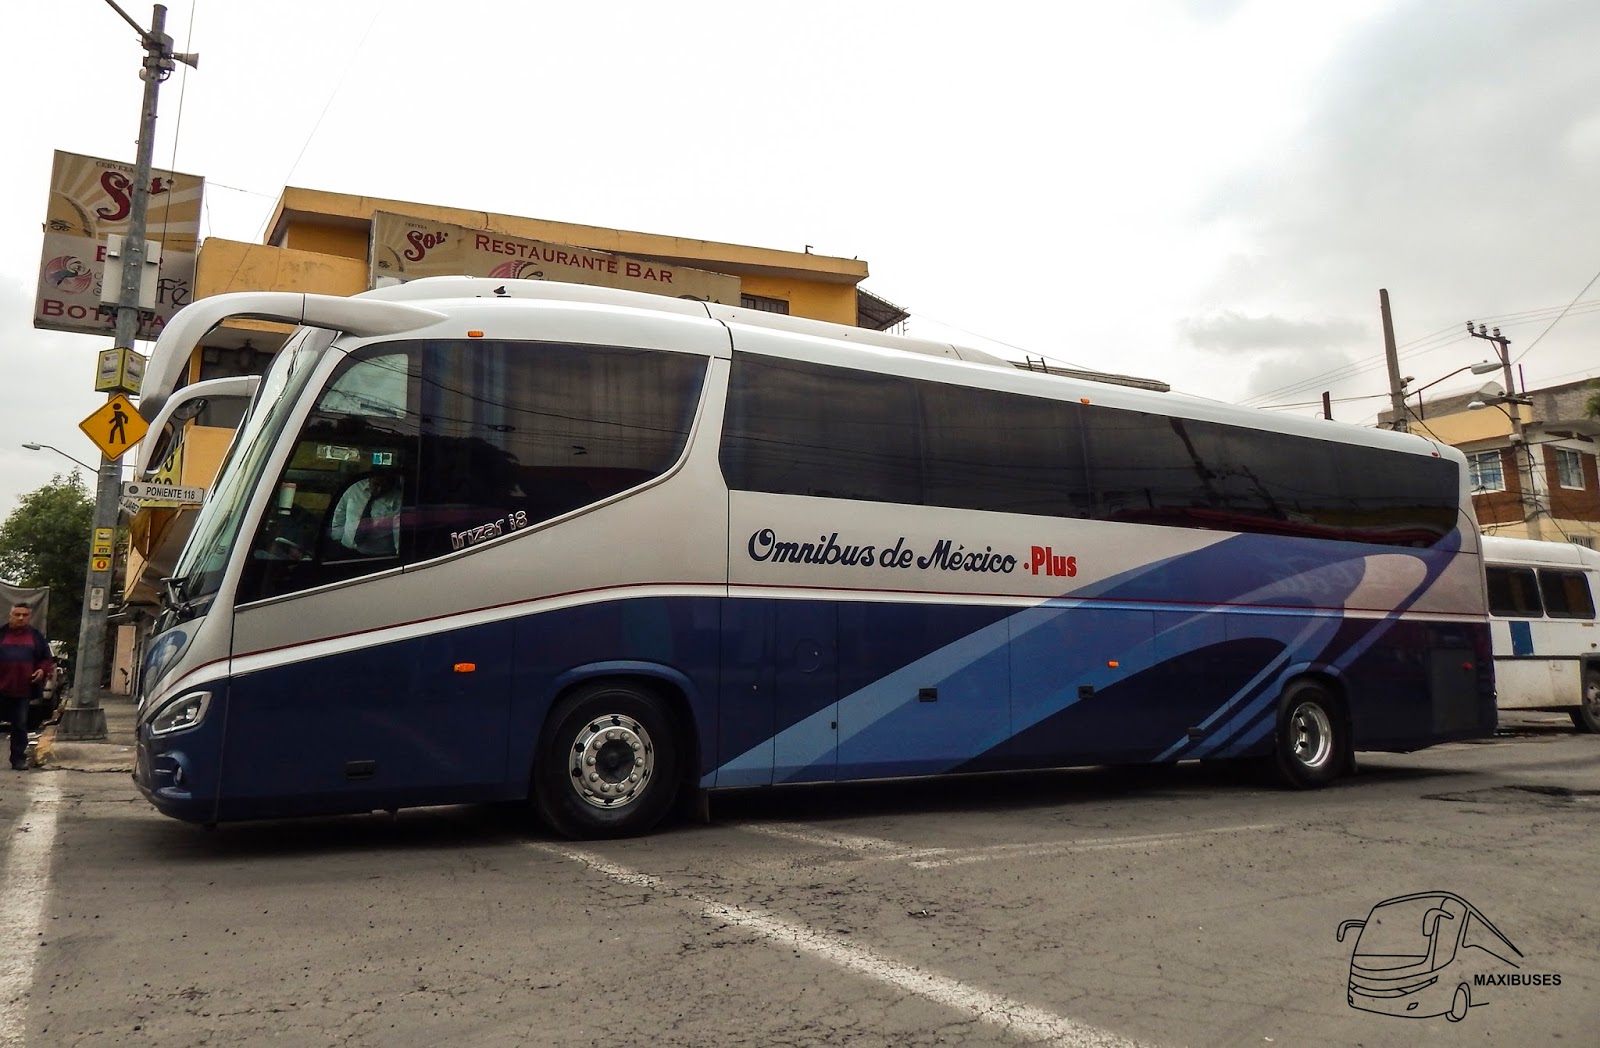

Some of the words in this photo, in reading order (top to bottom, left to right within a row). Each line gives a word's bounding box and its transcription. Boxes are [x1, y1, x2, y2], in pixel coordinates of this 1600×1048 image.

[96, 171, 172, 221] SL
[475, 233, 618, 274] RESTAURANTE
[626, 261, 673, 284] BAR
[146, 486, 182, 499] PONIENTE
[508, 510, 528, 531] i8
[748, 528, 876, 567] Omnibus
[879, 537, 914, 569] de
[917, 539, 1018, 574] México
